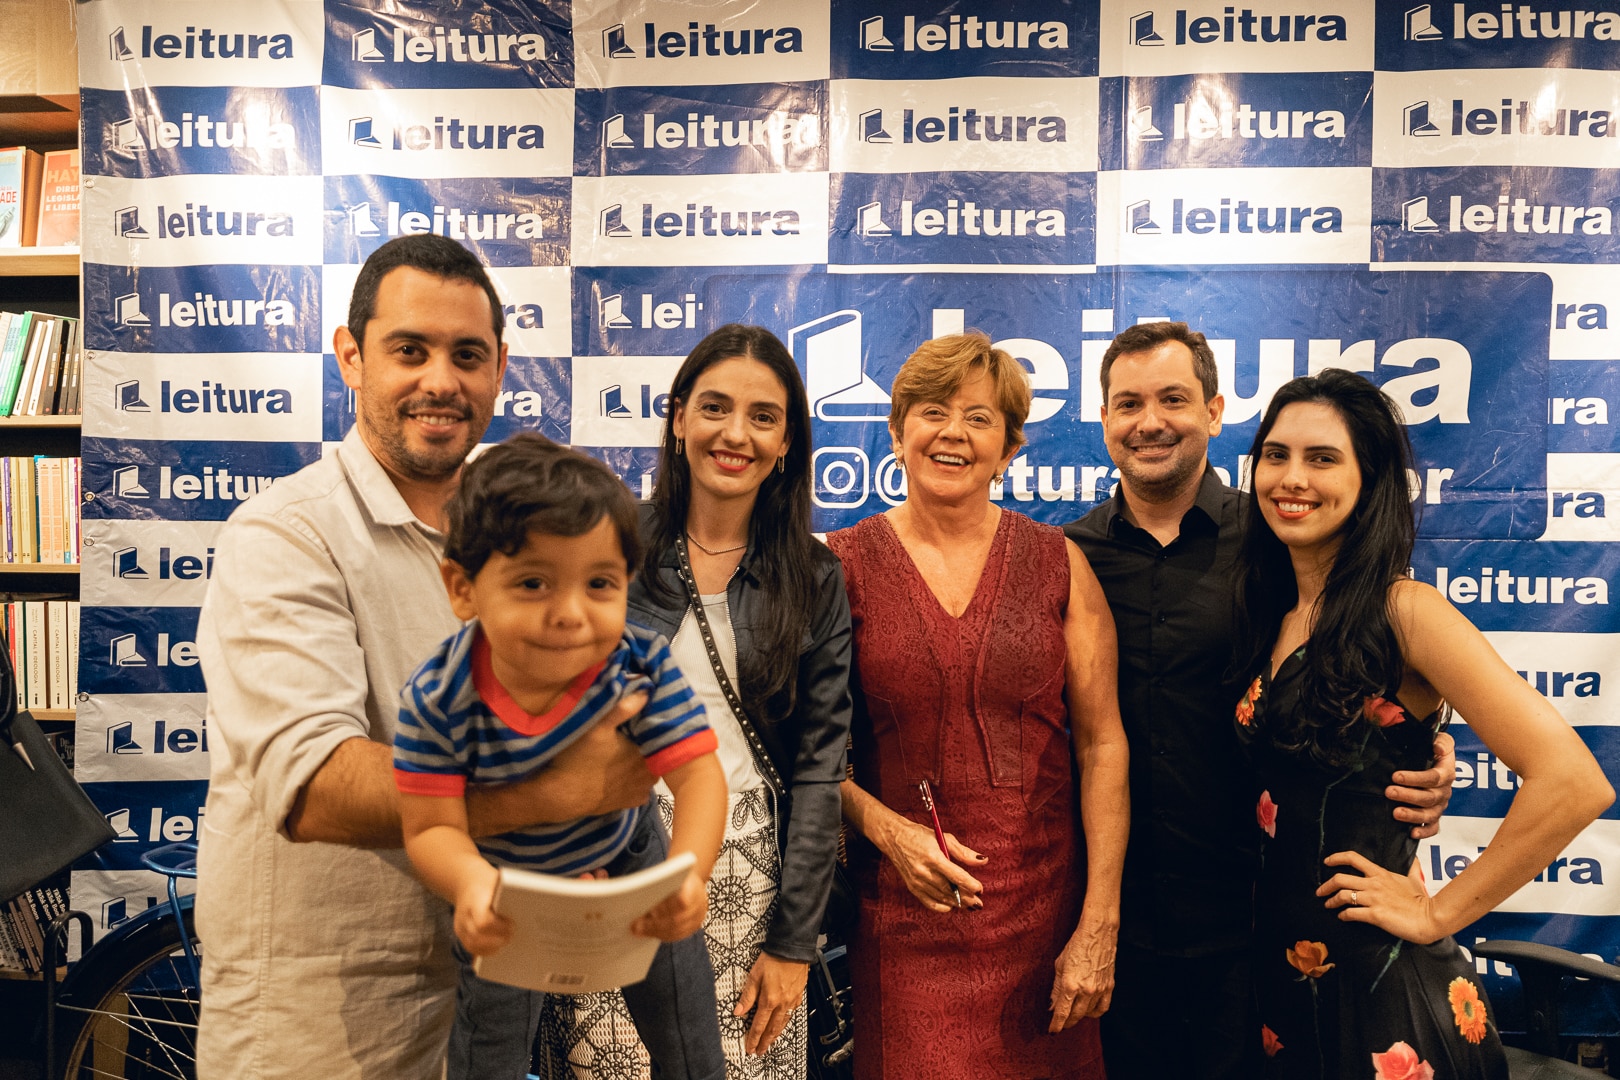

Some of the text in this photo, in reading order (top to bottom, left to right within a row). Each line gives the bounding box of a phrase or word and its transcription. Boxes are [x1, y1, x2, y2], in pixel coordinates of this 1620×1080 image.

[645, 22, 804, 58] leitura
[904, 15, 1069, 52] leitura
[1175, 7, 1348, 46] leitura
[1453, 3, 1620, 41] leitura
[142, 26, 294, 60] leitura
[394, 27, 547, 63] leitura
[147, 113, 296, 150] leitua
[392, 116, 545, 151] leitura
[643, 113, 804, 149] leitura
[903, 107, 1067, 144] leitura
[1173, 103, 1346, 139] leitura
[1452, 99, 1618, 138] leitura
[157, 203, 294, 239] leitura
[387, 202, 543, 241] leitura
[643, 203, 800, 237] leitura
[901, 199, 1066, 237] leitura
[1172, 198, 1343, 235] leitura
[1449, 195, 1612, 236] leitura
[159, 293, 295, 329] leitura
[642, 293, 703, 329] lei
[932, 308, 1472, 425] eiura
[161, 380, 293, 414] leitura
[1548, 397, 1608, 425] ra
[160, 466, 282, 500] leitur
[1436, 567, 1609, 605] leitura
